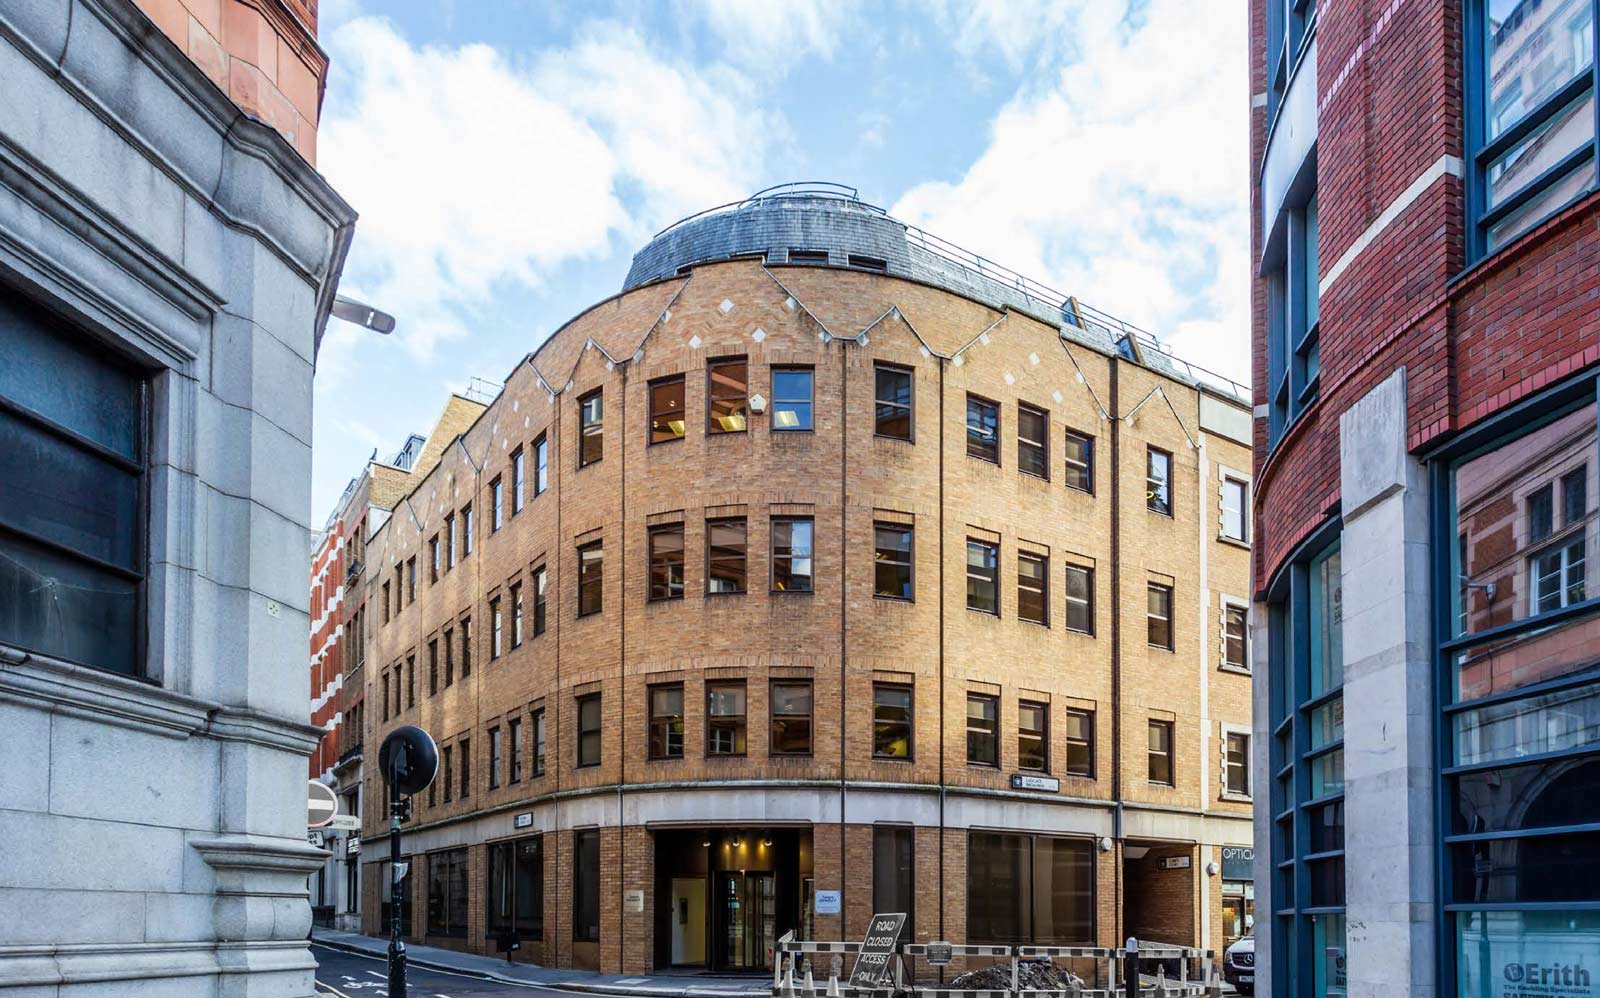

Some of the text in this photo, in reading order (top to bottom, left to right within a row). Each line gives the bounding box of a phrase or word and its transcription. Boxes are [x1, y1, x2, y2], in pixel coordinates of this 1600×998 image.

[876, 921, 896, 931] ROAD
[866, 936, 893, 947] CLOSED
[861, 954, 887, 964] ACCESS
[859, 971, 876, 982] ONLY
[1525, 962, 1590, 986] Erith
